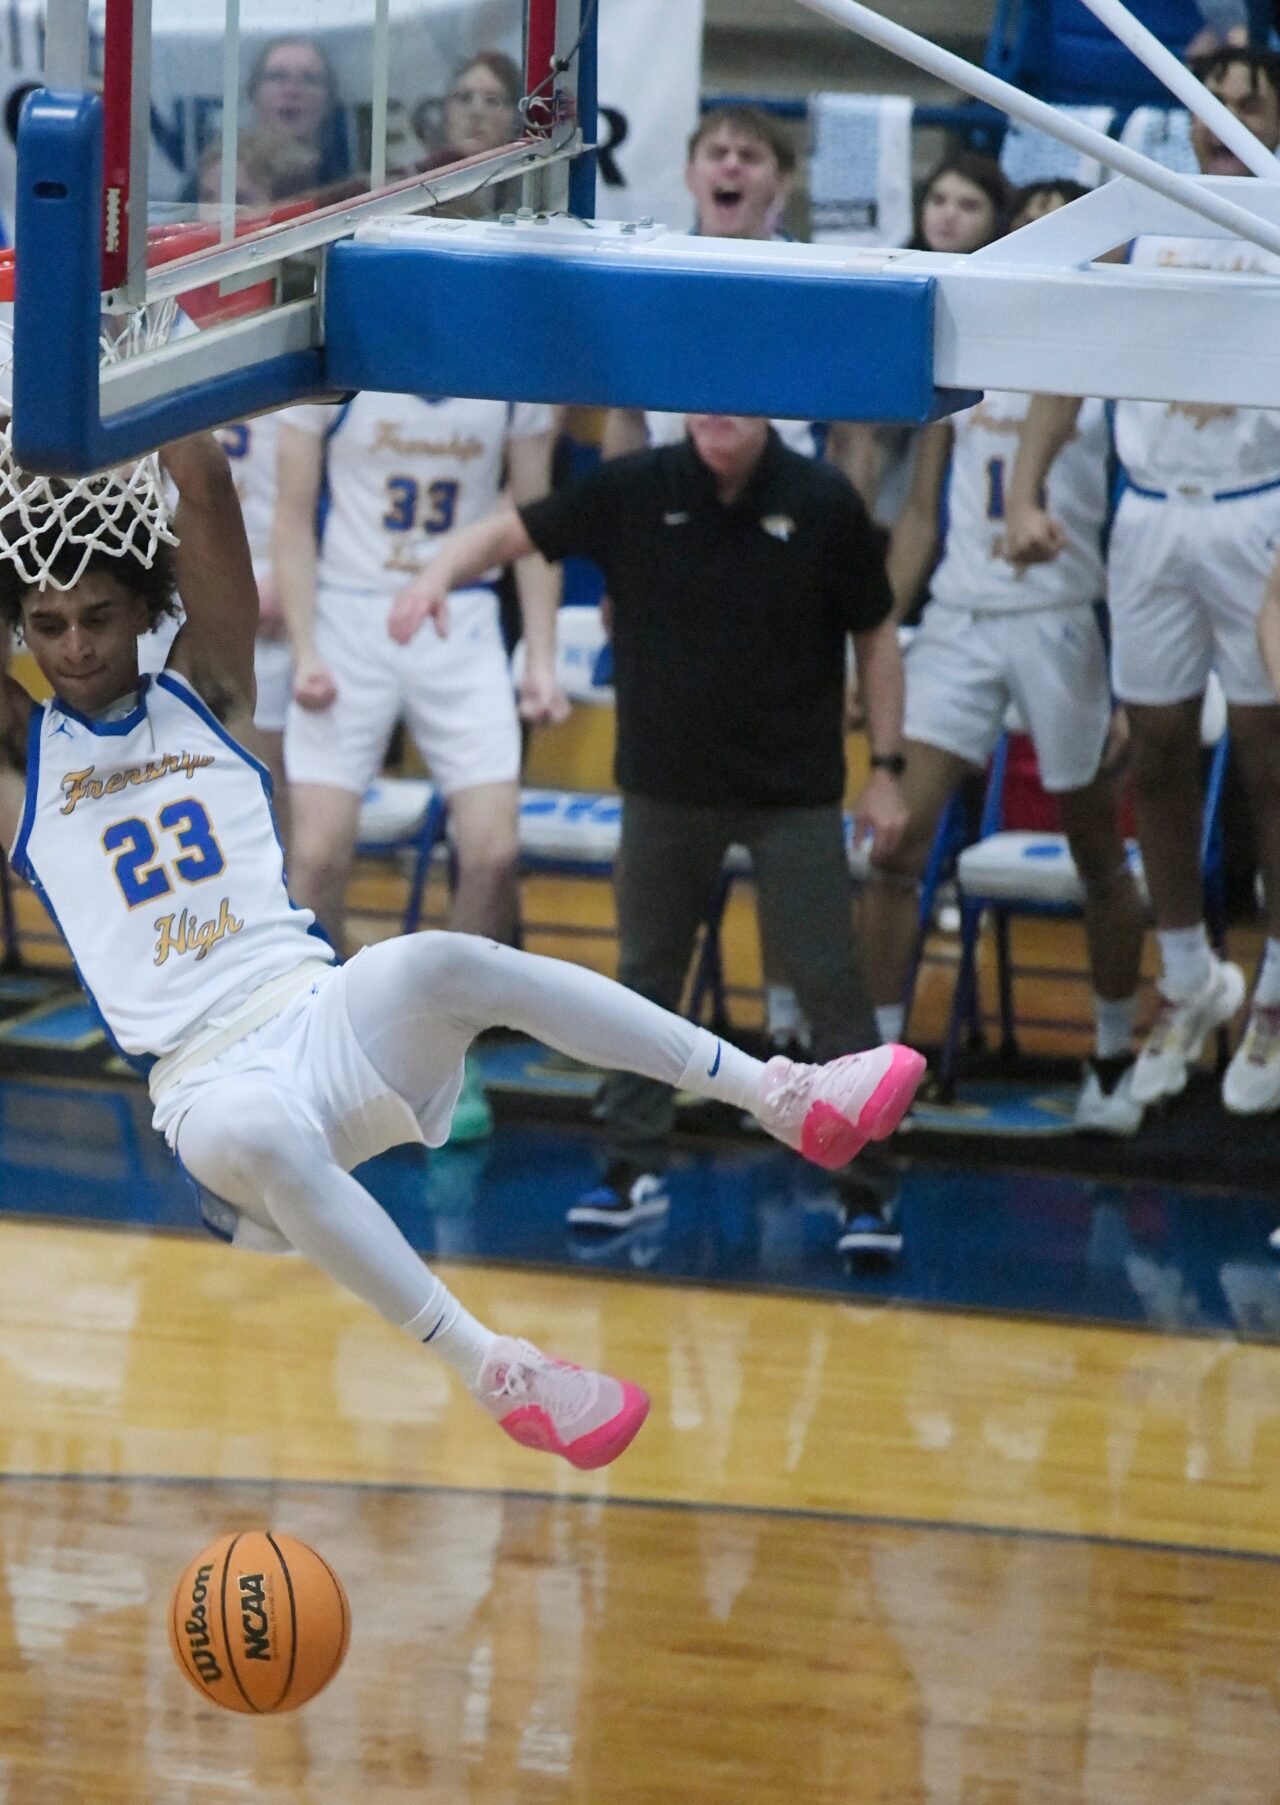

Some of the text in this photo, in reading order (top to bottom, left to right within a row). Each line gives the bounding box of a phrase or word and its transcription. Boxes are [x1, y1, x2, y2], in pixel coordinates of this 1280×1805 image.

[383, 475, 458, 534] 33
[100, 796, 227, 912] 23
[153, 897, 244, 966] High
[185, 1564, 222, 1684] Wilson
[238, 1572, 272, 1661] NCAA
